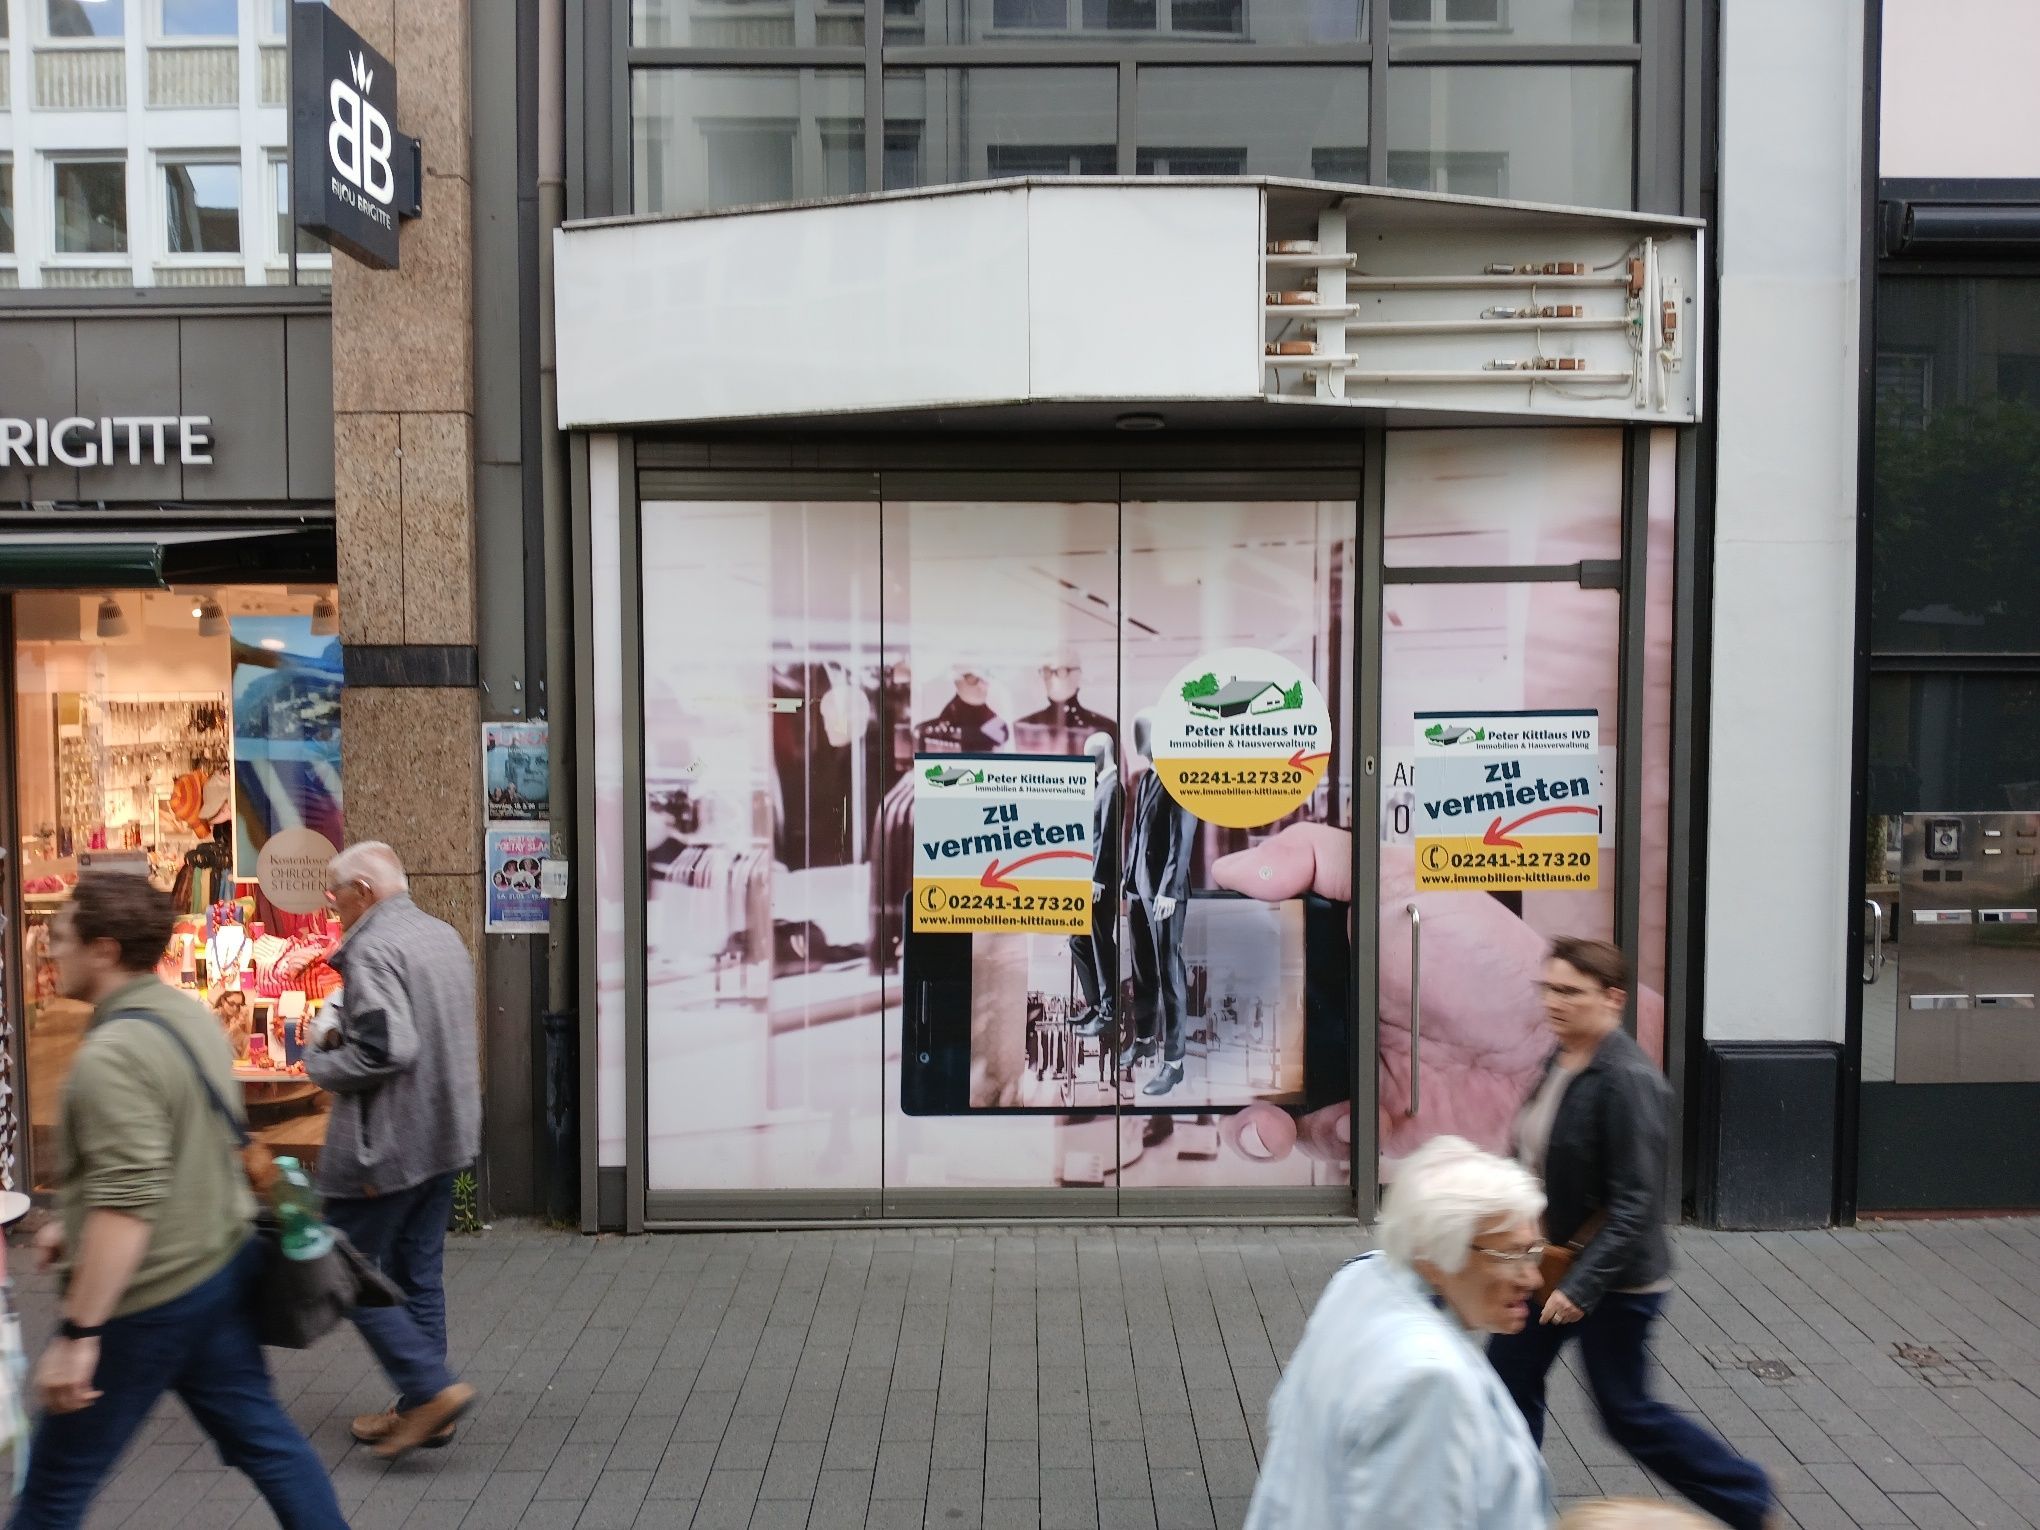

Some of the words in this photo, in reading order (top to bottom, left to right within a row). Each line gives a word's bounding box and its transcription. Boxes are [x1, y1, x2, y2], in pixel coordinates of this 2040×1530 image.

[331, 176, 356, 207] BIJOU
[357, 193, 392, 231] BRIGITTE
[1185, 724, 1225, 736] Peter
[1230, 723, 1288, 736] Kittlaus
[1293, 724, 1318, 736] IVD
[1488, 730, 1520, 740] Peter
[1522, 729, 1568, 740] Kittlaus
[1571, 729, 1591, 740] IVD
[1169, 739, 1225, 748] Immobilien
[1228, 740, 1234, 748] &
[1237, 739, 1316, 750] Hausverwaltung
[1476, 742, 1518, 750] Immobilien
[1528, 741, 1589, 750] Hausverwaltung
[1484, 760, 1521, 783] zu
[987, 773, 1017, 784] Peter
[1021, 774, 1065, 785] Kittlaus
[1068, 775, 1087, 785] IVD
[975, 785, 1017, 793] Immobilien
[1026, 786, 1086, 795] Hausverwaltung
[1179, 787, 1302, 796] www.immobilien-kittlaus.de
[1423, 776, 1590, 820] vermieten
[982, 803, 1019, 825] zu
[923, 821, 1086, 861] vermieten
[271, 868, 327, 879] OHRLOCH
[1421, 872, 1591, 883] www.immobilien-kittlaus.de
[271, 880, 328, 891] STECHEN
[919, 915, 1084, 927] www.immobilien-kittlaus.de
